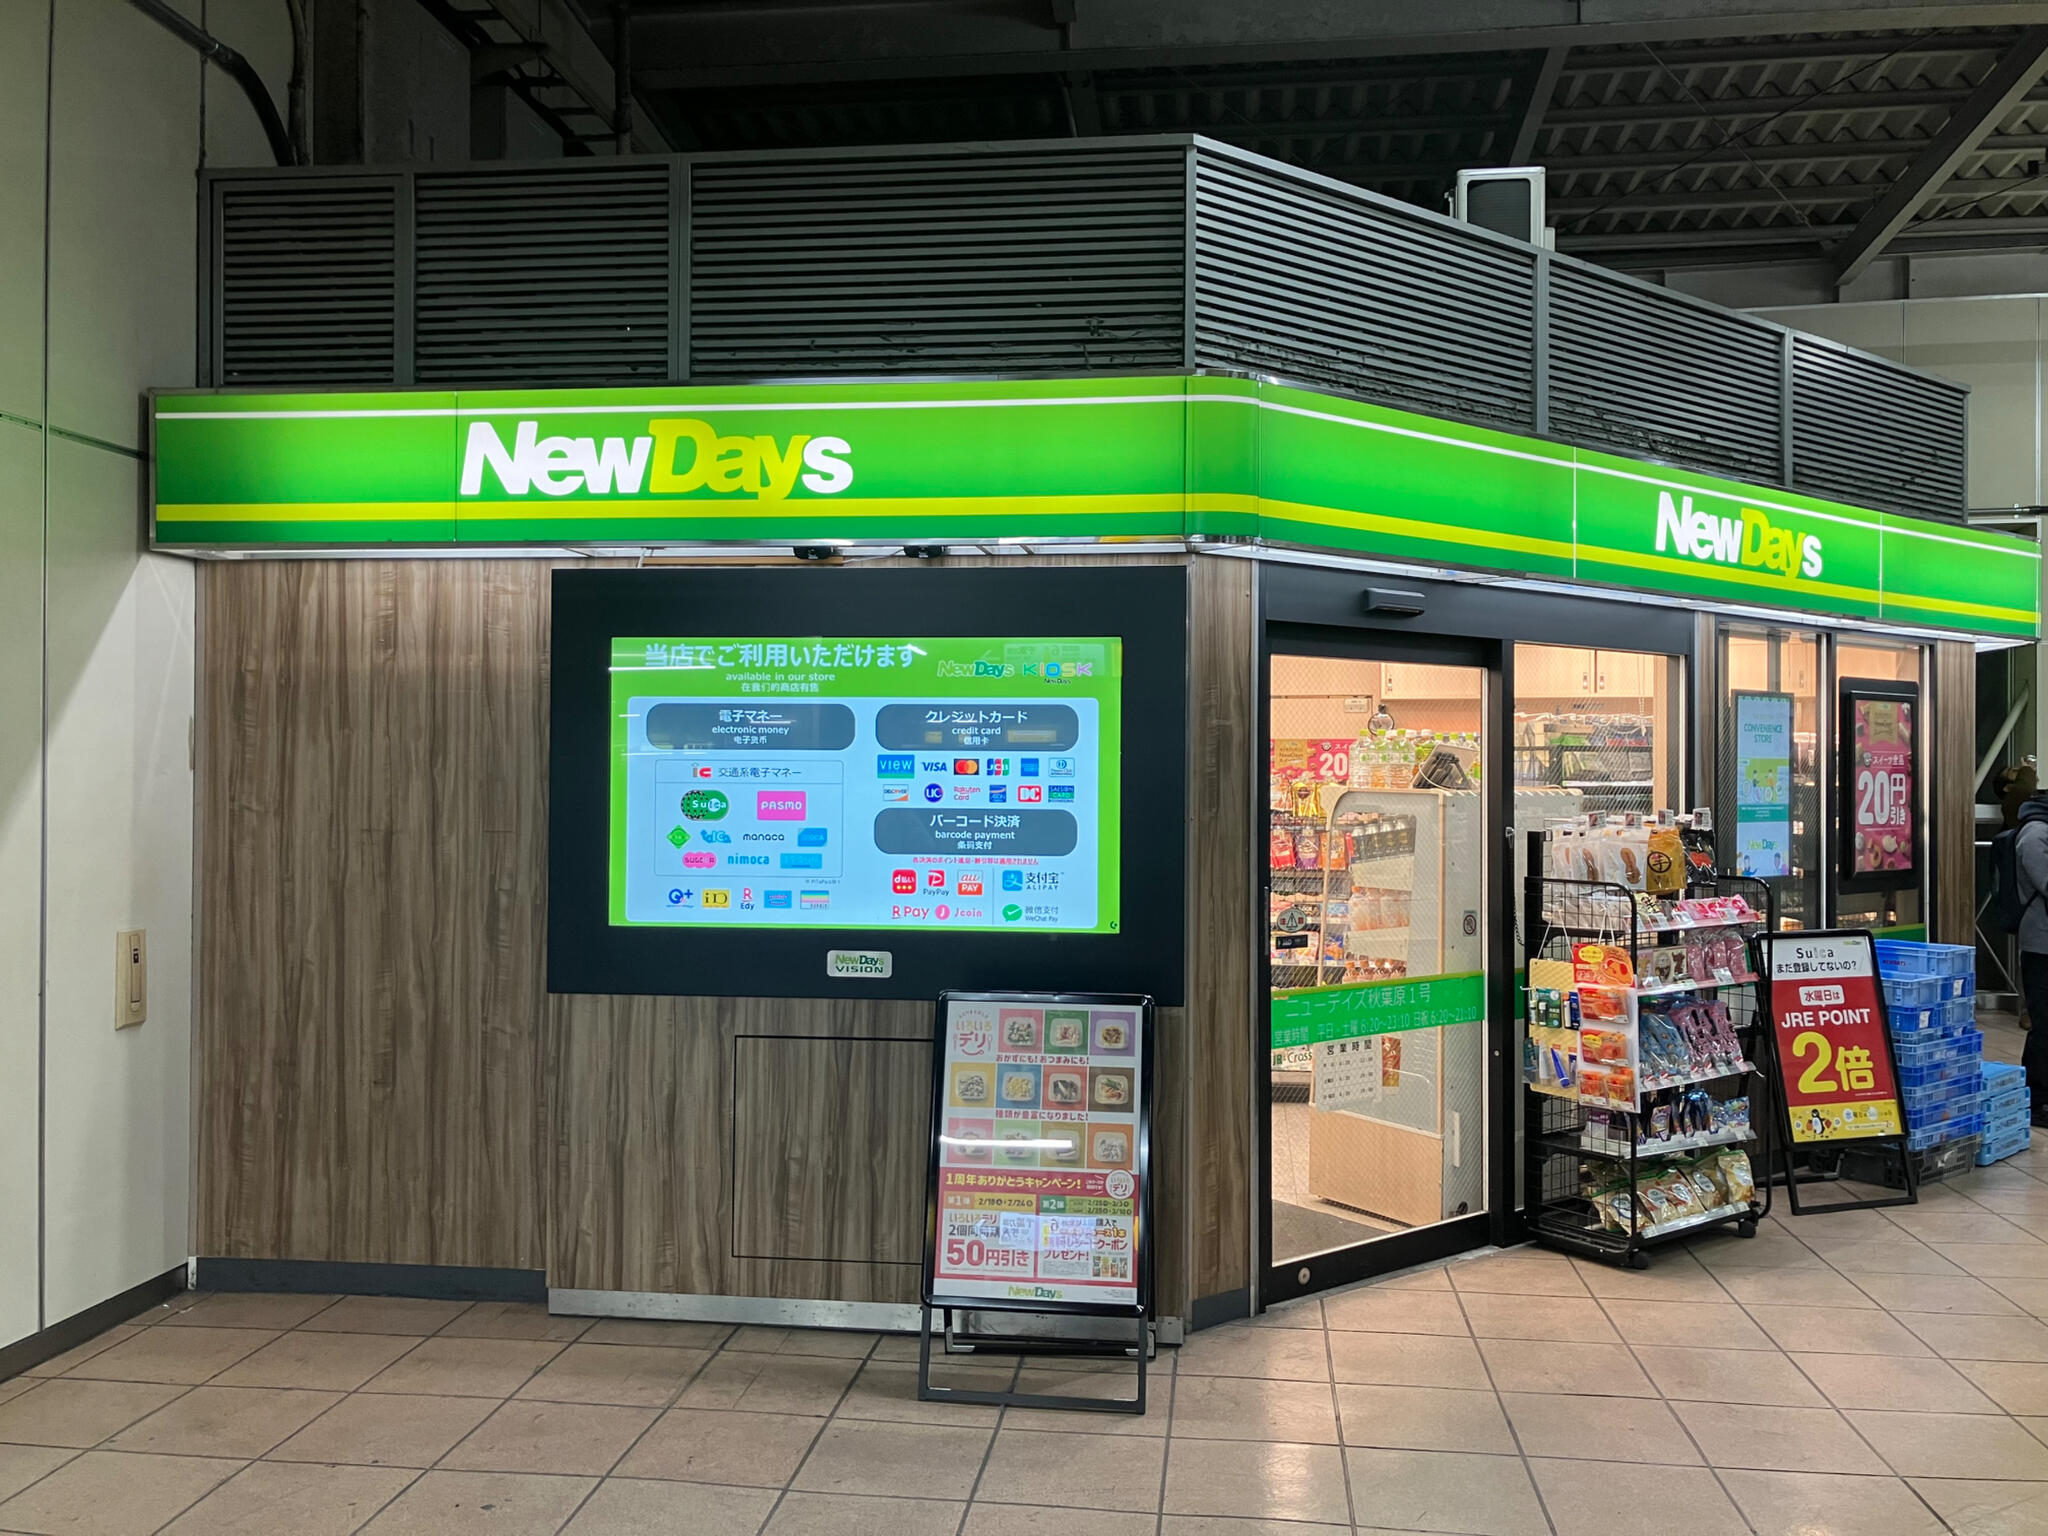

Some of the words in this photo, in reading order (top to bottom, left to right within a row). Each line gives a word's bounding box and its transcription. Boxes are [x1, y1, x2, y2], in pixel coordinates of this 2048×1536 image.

[460, 418, 854, 500] NewDays
[1655, 491, 1823, 578] NewDays
[645, 642, 914, 668] 当店でご利用いただけます
[937, 660, 1015, 678] NewDays
[1023, 662, 1092, 678] KIOSK
[726, 672, 771, 682] available
[775, 672, 784, 682] in
[788, 674, 805, 682] our
[808, 673, 835, 682] store
[719, 710, 782, 722] 電子マネー
[925, 711, 1028, 724] クレジットカード
[712, 726, 756, 734] electronic
[758, 727, 789, 736] money
[952, 727, 978, 735] credit
[980, 727, 1001, 735] card
[1744, 723, 1783, 733] CONVENIENCE
[1754, 734, 1772, 743] STORE
[922, 762, 947, 772] VISA
[1320, 752, 1348, 777] 20
[718, 768, 802, 778] 交通系電子マネー
[926, 789, 941, 798] UC
[954, 793, 970, 801] Card
[693, 799, 727, 809] Suica
[761, 801, 802, 810] PASMO
[930, 814, 1021, 828] バーコード決済
[743, 833, 785, 841] manaca
[935, 830, 972, 839] barcode
[974, 831, 1015, 841] payment
[728, 854, 770, 865] nimoca
[1026, 873, 1059, 884] 支付宝
[923, 889, 949, 897] PayPay
[961, 884, 978, 892] PAY
[705, 893, 728, 905] iD
[741, 902, 755, 910] Edy
[903, 906, 929, 919] Pay
[1048, 915, 1059, 923] Pay
[835, 954, 885, 966] NewDays
[1777, 960, 1857, 973] まだ登録してないの?
[1804, 989, 1840, 1002] 水曜日は
[1781, 1012, 1815, 1028] JRE
[1818, 1008, 1870, 1026] POINT
[956, 1020, 992, 1031] いろいろ
[959, 1032, 987, 1048] デリ
[1275, 1026, 1309, 1046] 営業時間
[1792, 1031, 1875, 1094] 2倍
[946, 1172, 1081, 1189] 1周年ありがとうキャンペーン!
[1112, 1184, 1128, 1193] デリ
[947, 1238, 1030, 1267] 50円引き
[1008, 1286, 1063, 1299] NewDays
